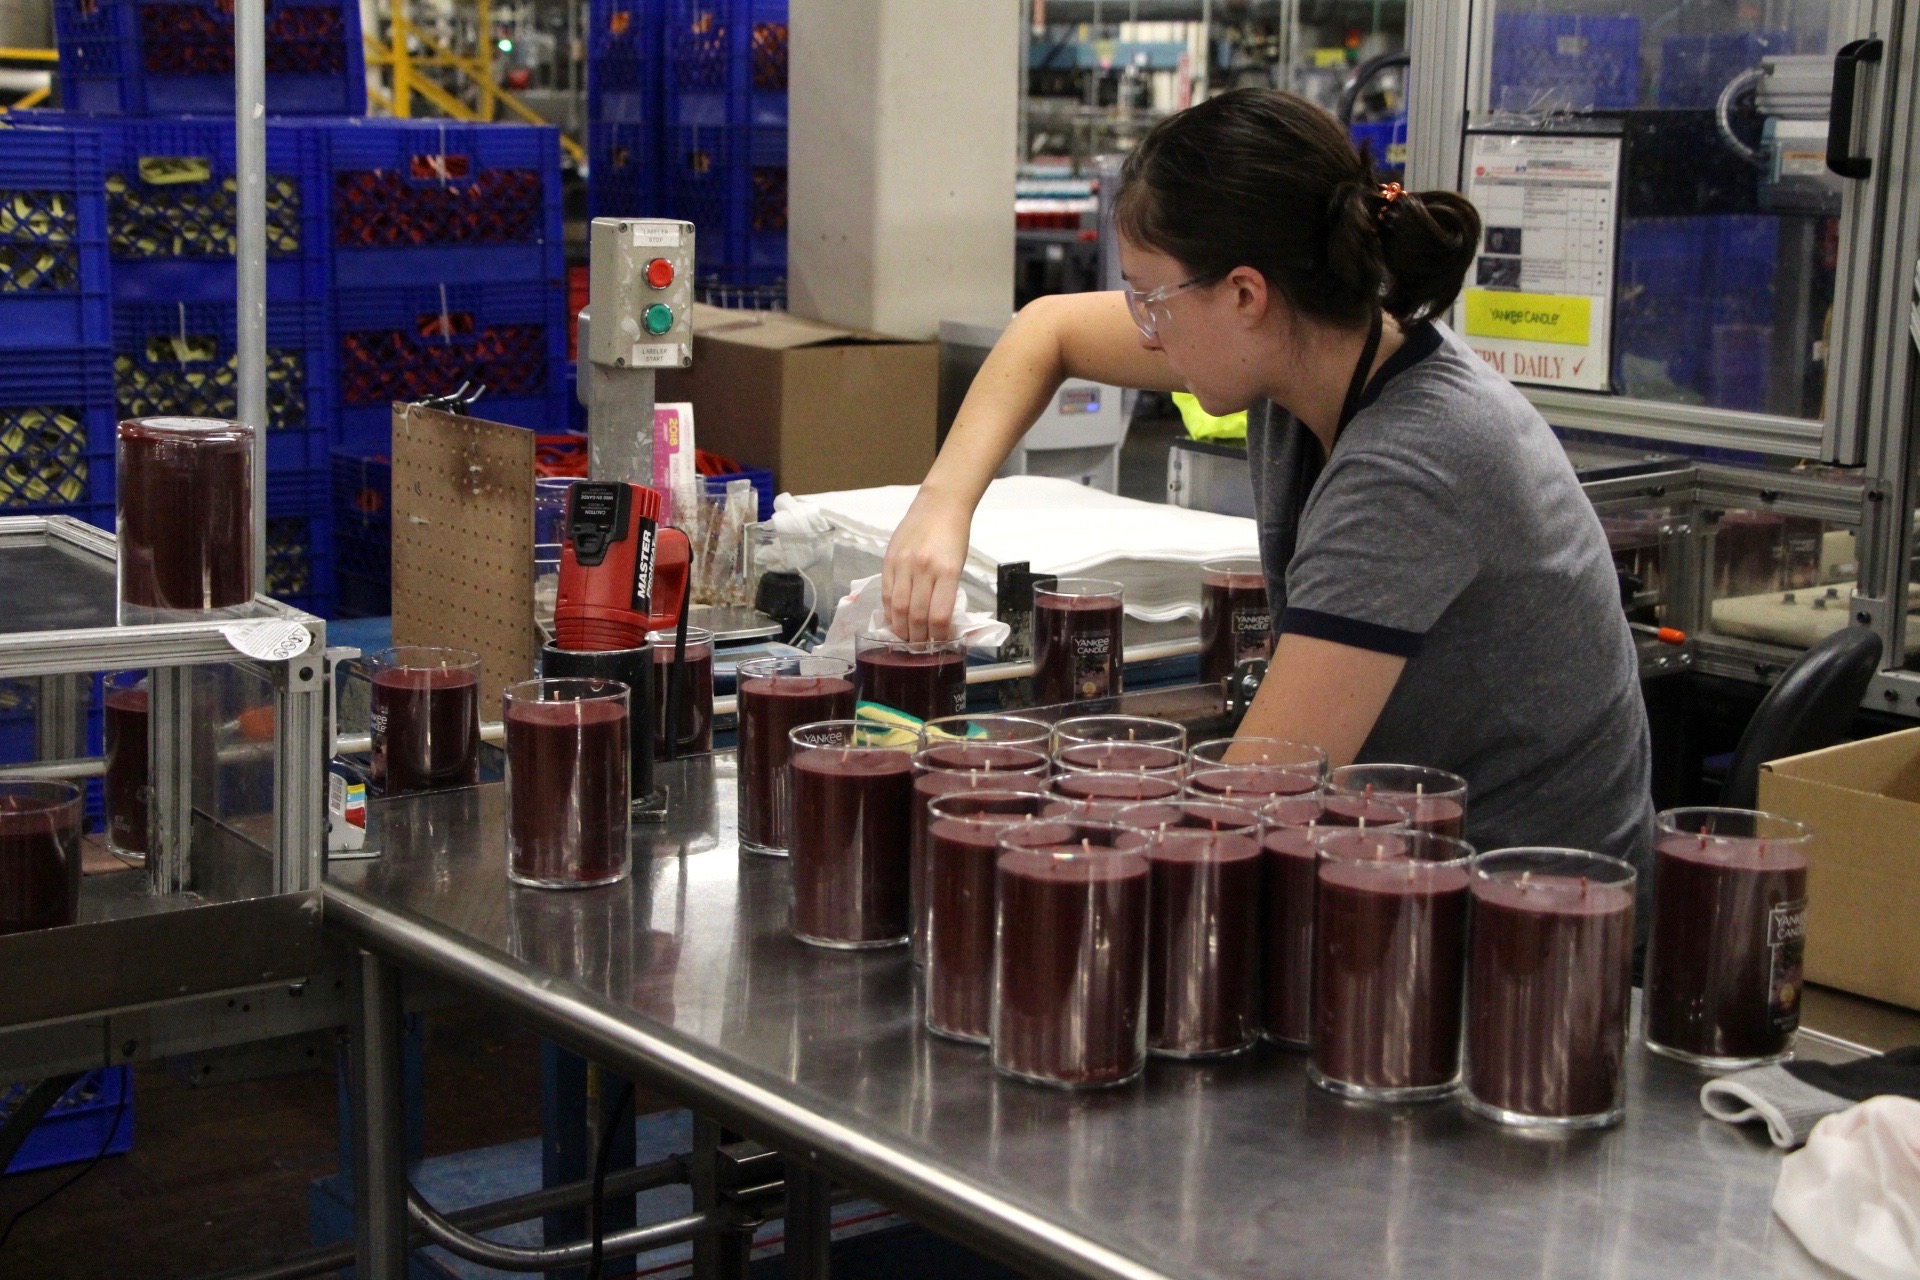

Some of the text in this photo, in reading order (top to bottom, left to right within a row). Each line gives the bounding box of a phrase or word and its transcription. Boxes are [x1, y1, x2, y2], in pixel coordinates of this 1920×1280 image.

[1514, 352, 1564, 379] DAILY
[668, 417, 679, 446] 2018
[637, 529, 652, 599] MASTER
